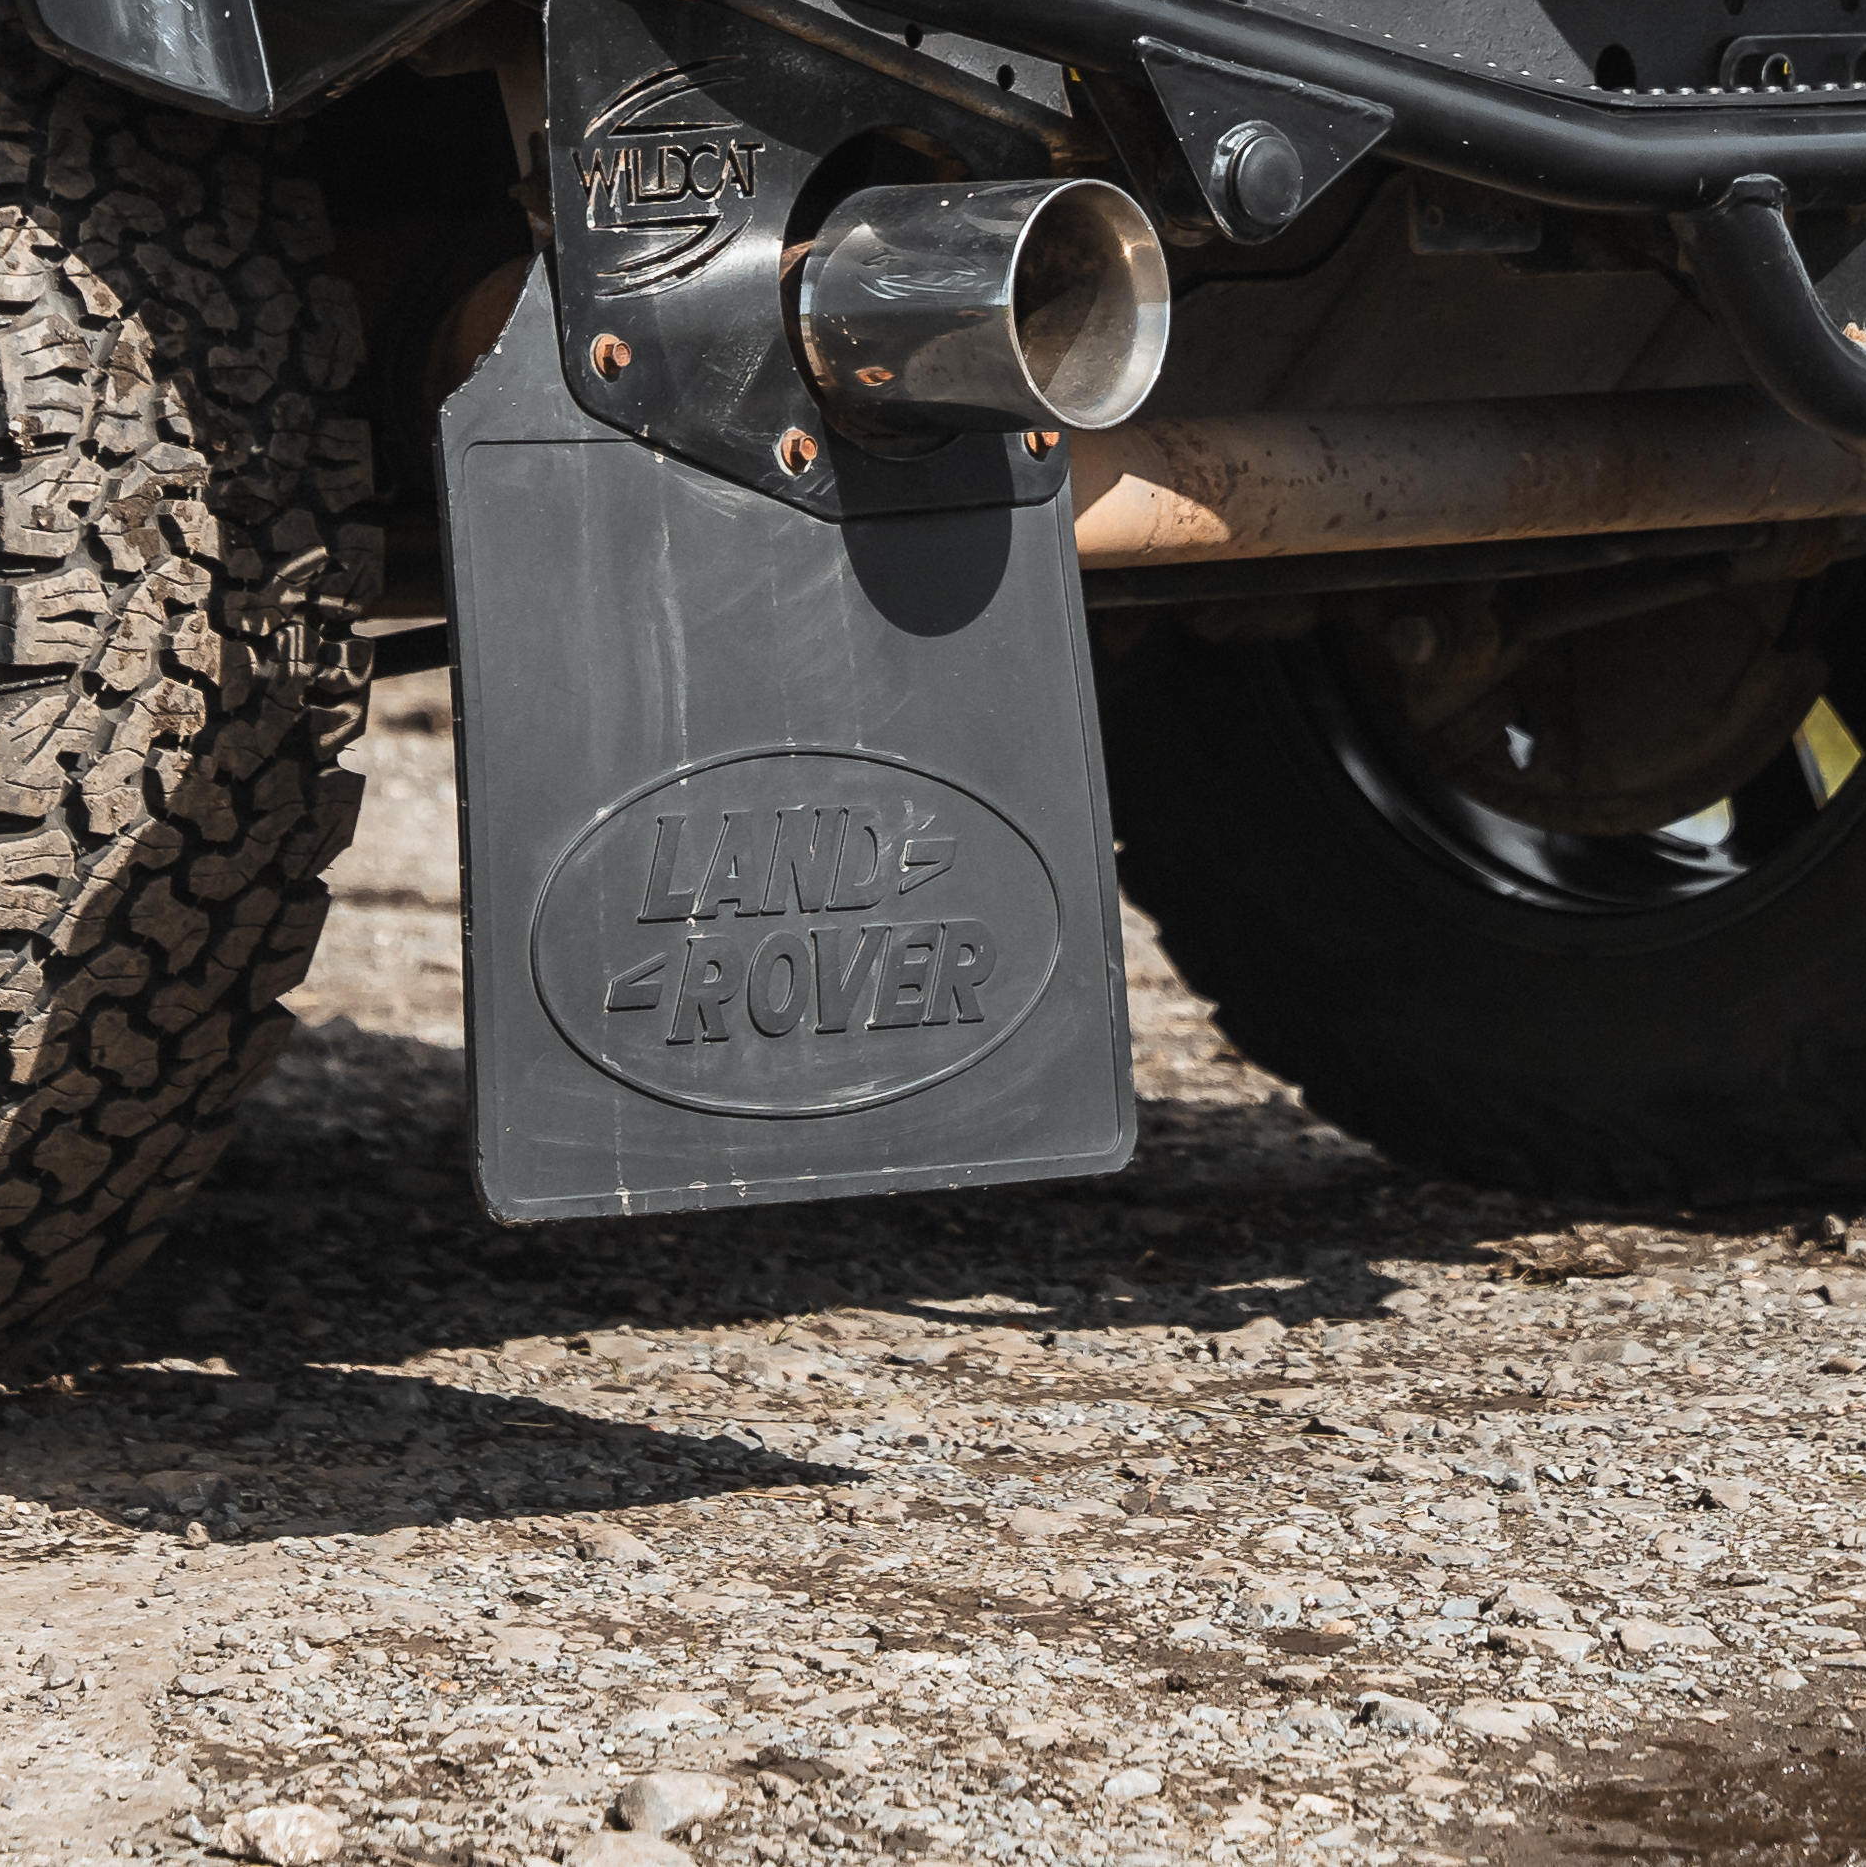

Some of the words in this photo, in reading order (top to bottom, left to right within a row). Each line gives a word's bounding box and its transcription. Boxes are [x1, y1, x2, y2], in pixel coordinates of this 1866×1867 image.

[571, 141, 765, 210] WILDCAT
[637, 804, 885, 924] LAND
[665, 918, 996, 1045] ROVER
